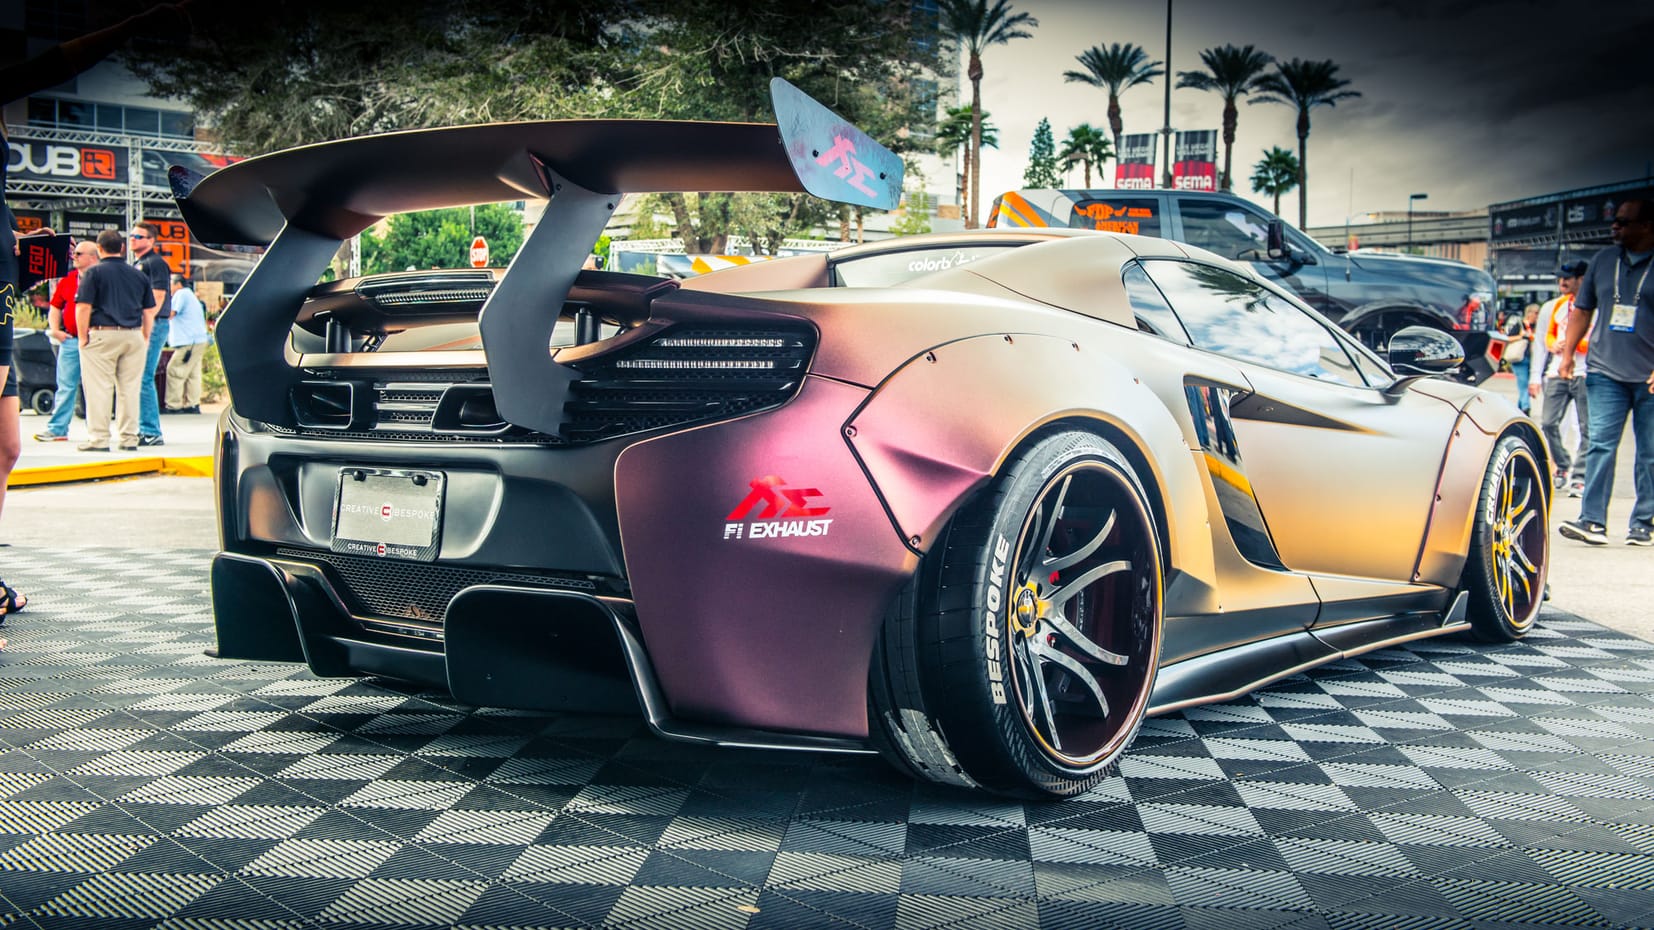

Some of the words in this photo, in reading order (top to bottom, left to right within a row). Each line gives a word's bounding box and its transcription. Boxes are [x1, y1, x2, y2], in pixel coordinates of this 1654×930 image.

[6, 142, 81, 176] DUB
[1117, 177, 1152, 190] SEMA
[1175, 175, 1213, 190] SEMA
[155, 224, 186, 239] UB
[341, 503, 379, 515] CREATIVE
[393, 508, 435, 520] BESPOKE
[723, 523, 744, 539] Fi
[748, 519, 833, 539] EXHAUST
[347, 542, 376, 553] CREATIVE
[387, 547, 418, 558] BESPOKE
[985, 533, 1010, 704] BESPOKE
